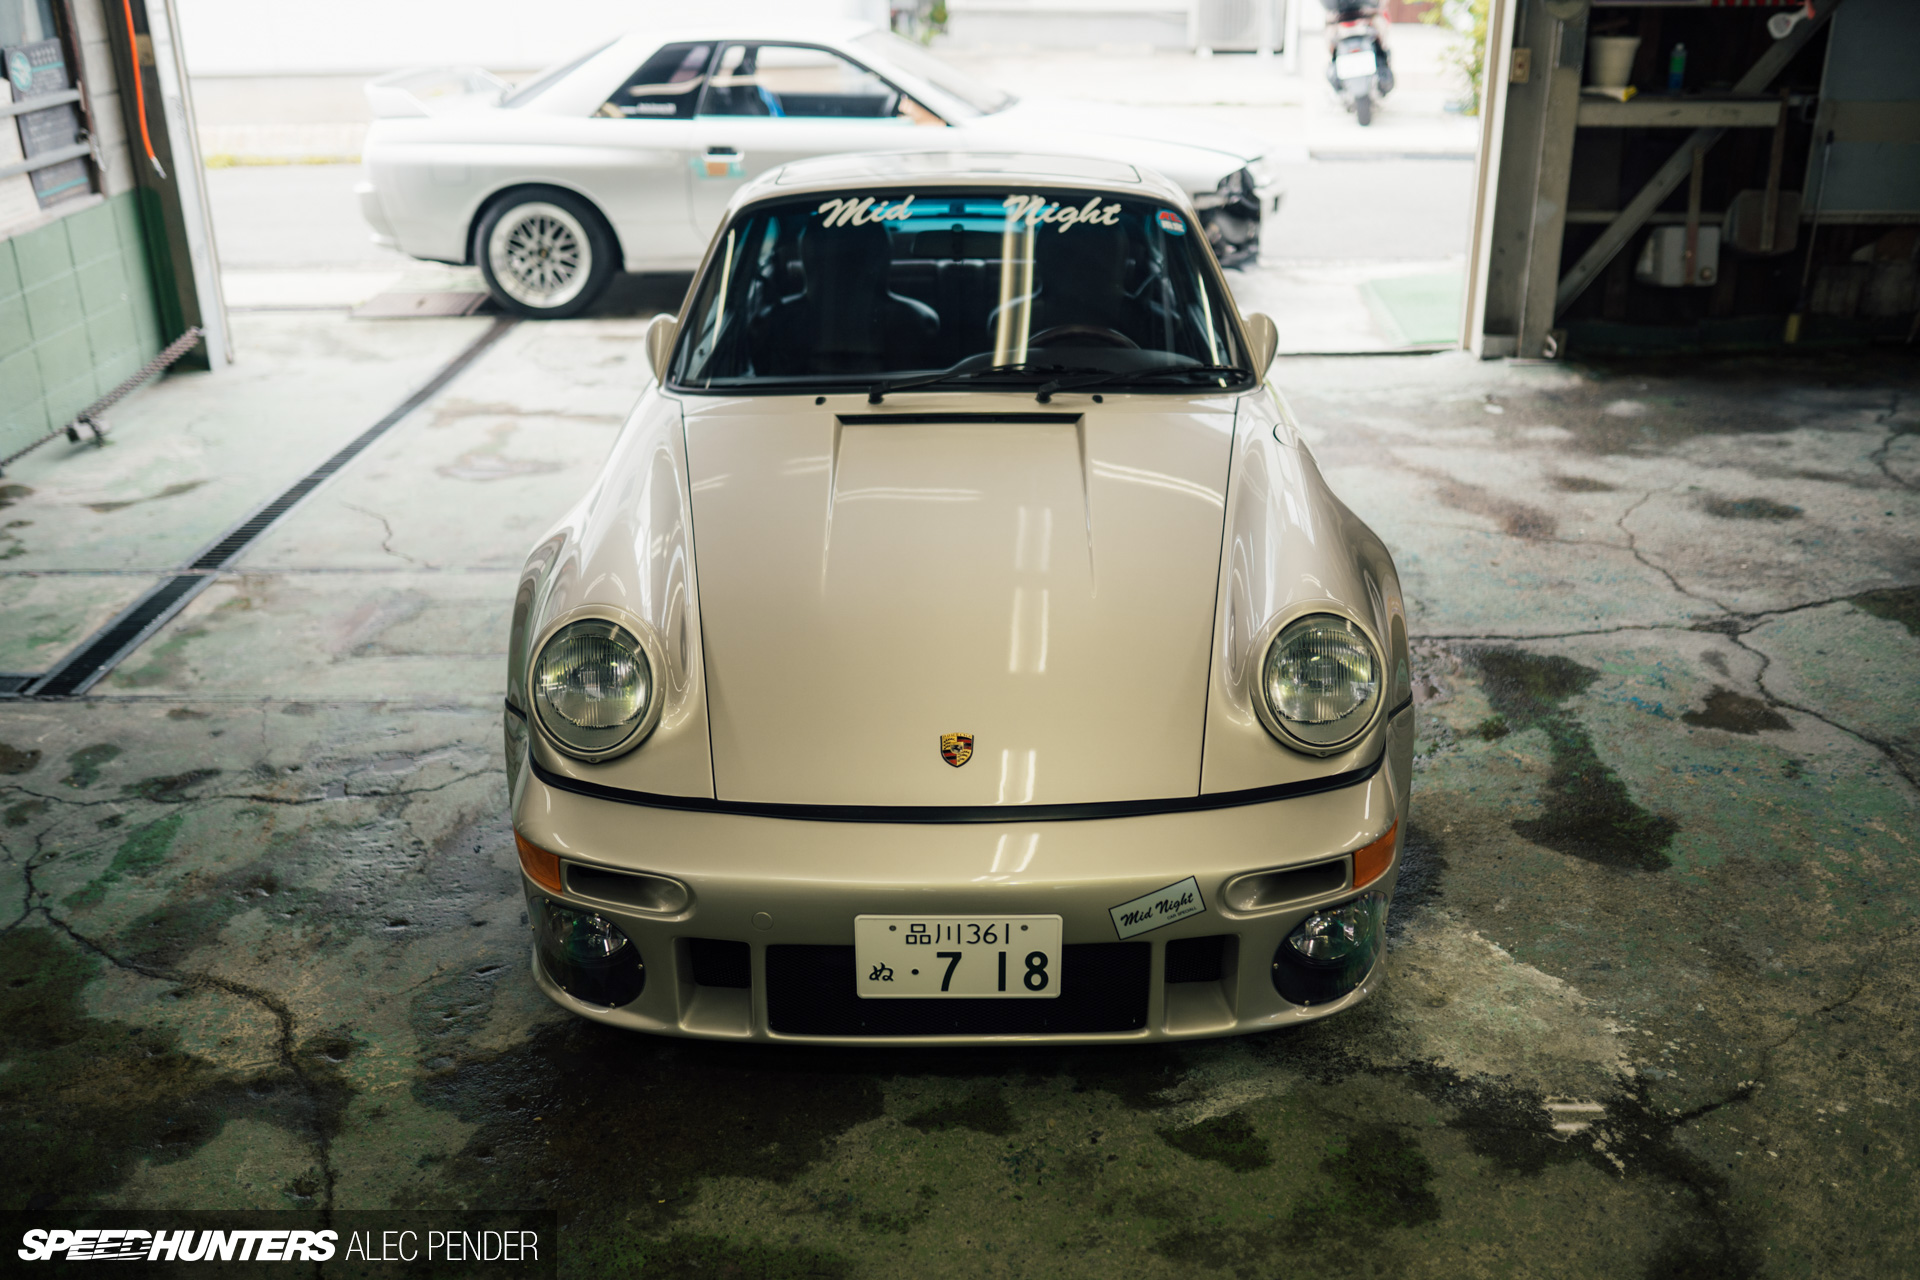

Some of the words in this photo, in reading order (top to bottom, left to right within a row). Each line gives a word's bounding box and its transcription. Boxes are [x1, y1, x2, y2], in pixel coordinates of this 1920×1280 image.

[818, 194, 915, 228] Mid
[1002, 194, 1122, 234] Night
[1120, 906, 1153, 927] Mid
[1155, 892, 1194, 914] Night
[868, 962, 895, 982] ぬ
